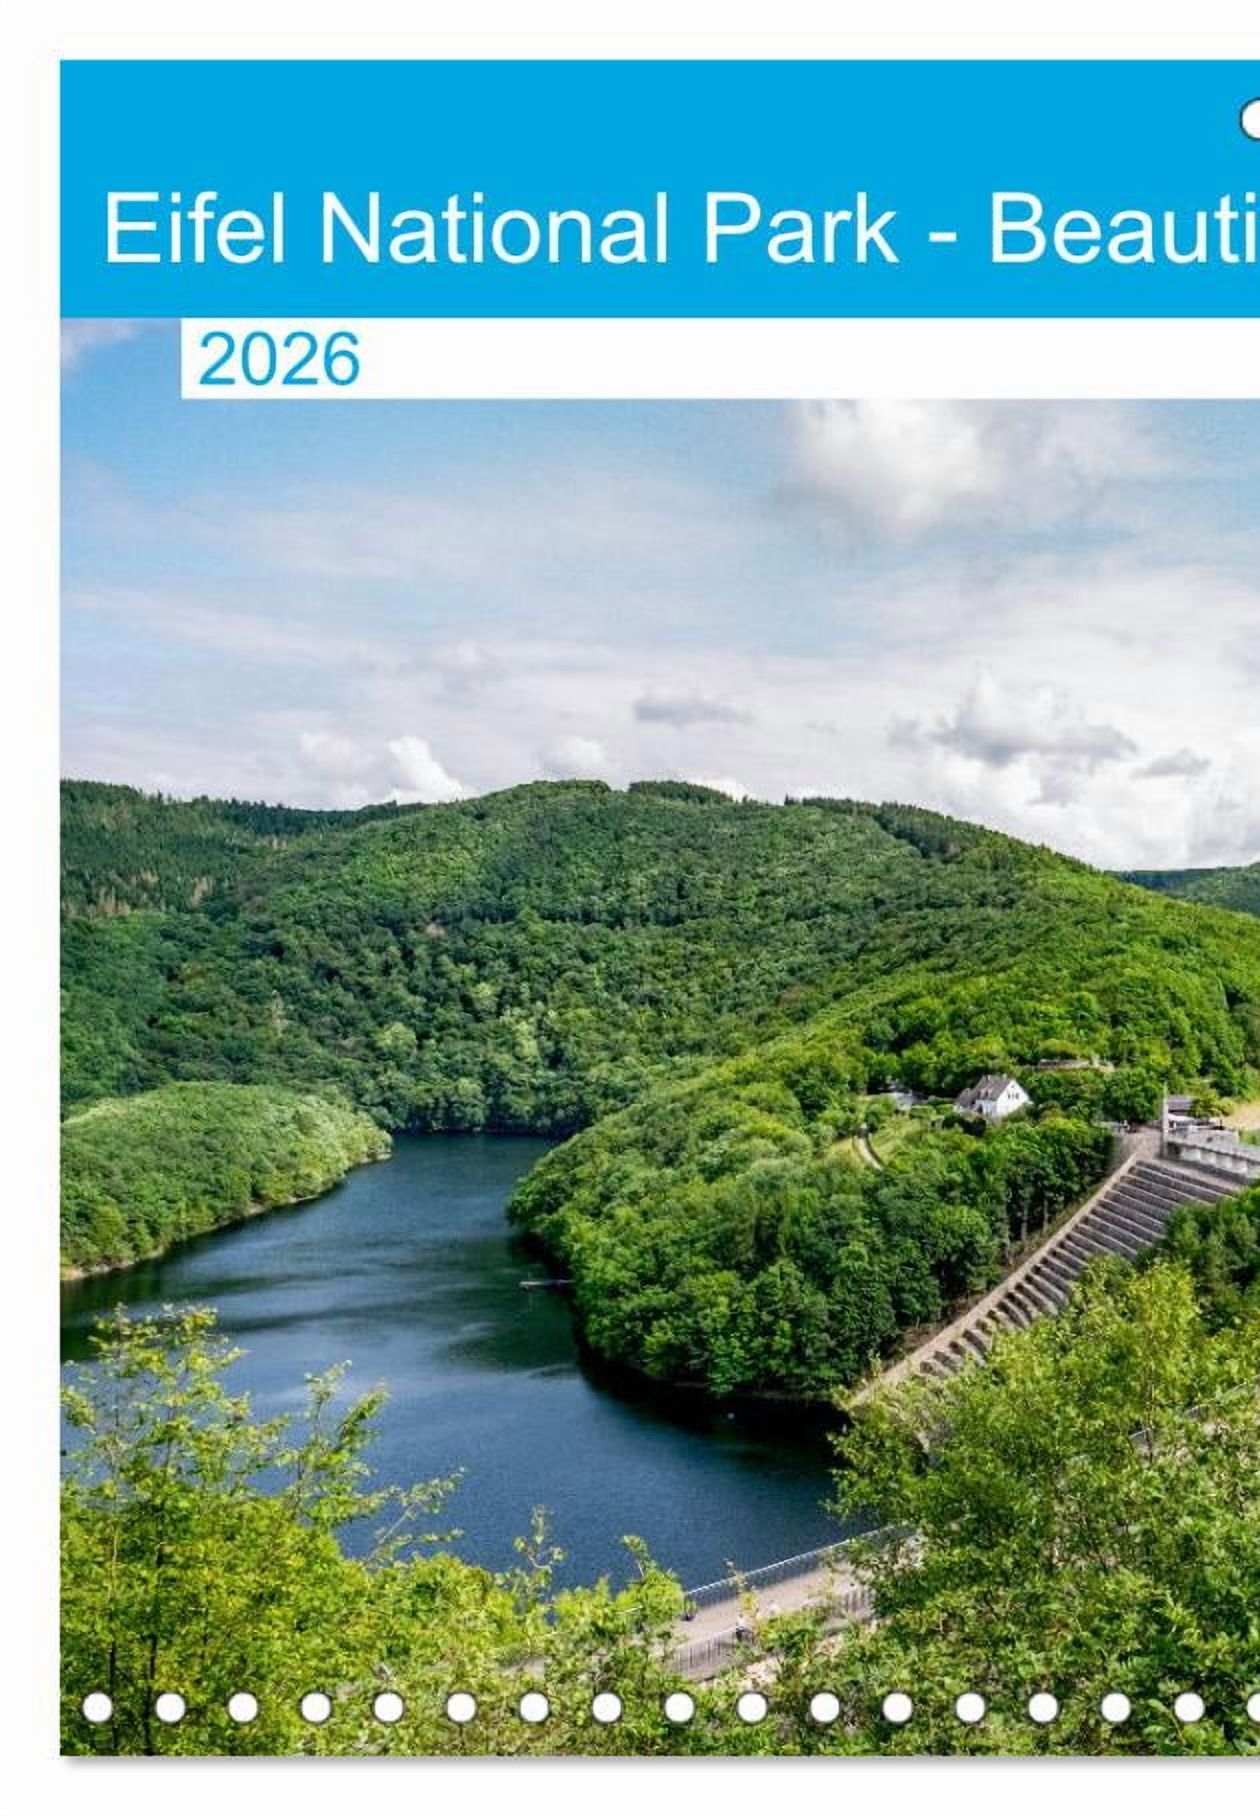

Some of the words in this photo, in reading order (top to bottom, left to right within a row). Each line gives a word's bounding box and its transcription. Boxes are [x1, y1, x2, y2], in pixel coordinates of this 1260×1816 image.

[107, 191, 284, 264] Eifel
[322, 191, 667, 264] National
[706, 191, 899, 264] Park
[930, 232, 956, 241] -
[199, 330, 360, 386] 2026
